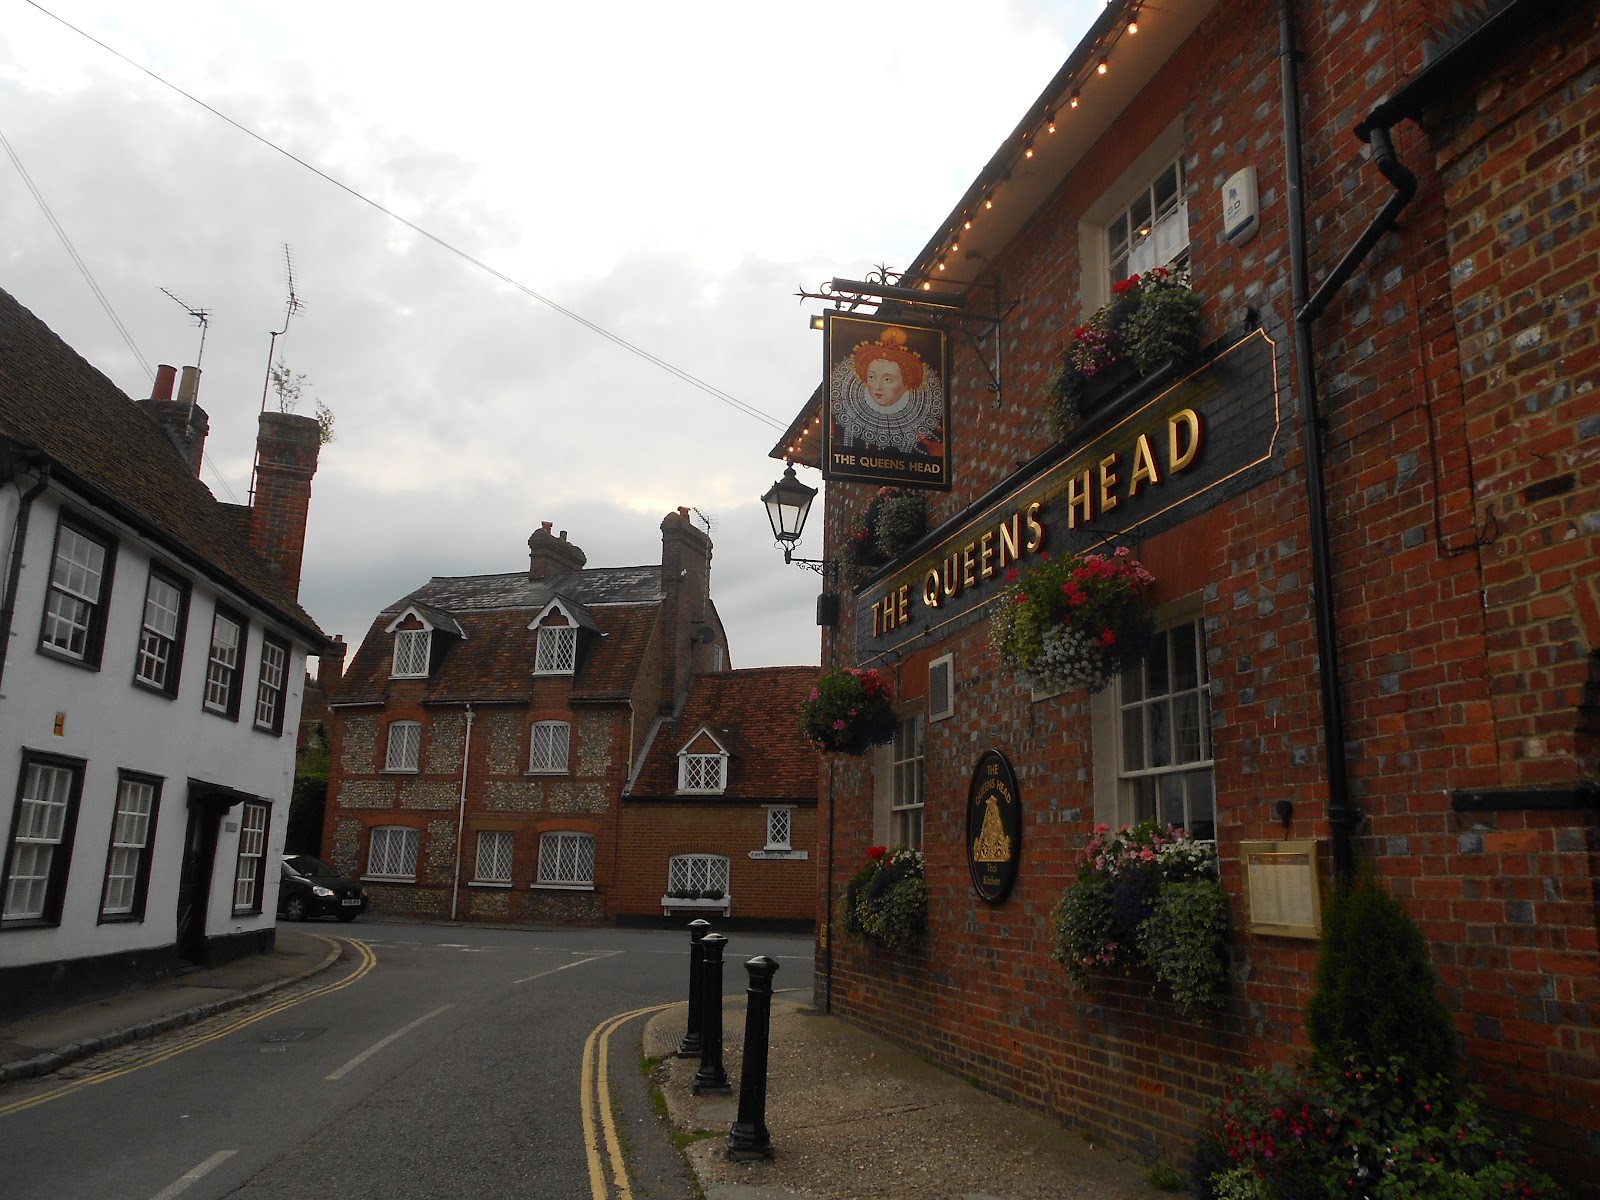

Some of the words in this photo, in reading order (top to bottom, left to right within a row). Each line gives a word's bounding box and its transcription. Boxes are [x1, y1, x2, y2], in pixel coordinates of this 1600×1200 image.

[834, 453, 856, 465] THE
[860, 457, 905, 471] QUEENS
[909, 462, 940, 474] HEAD
[871, 584, 909, 638] THE
[923, 502, 1043, 608] QUEENS
[1068, 408, 1202, 530] HEAD
[987, 764, 998, 776] THE
[975, 778, 996, 805] QUEENS
[996, 779, 1011, 803] HEAD
